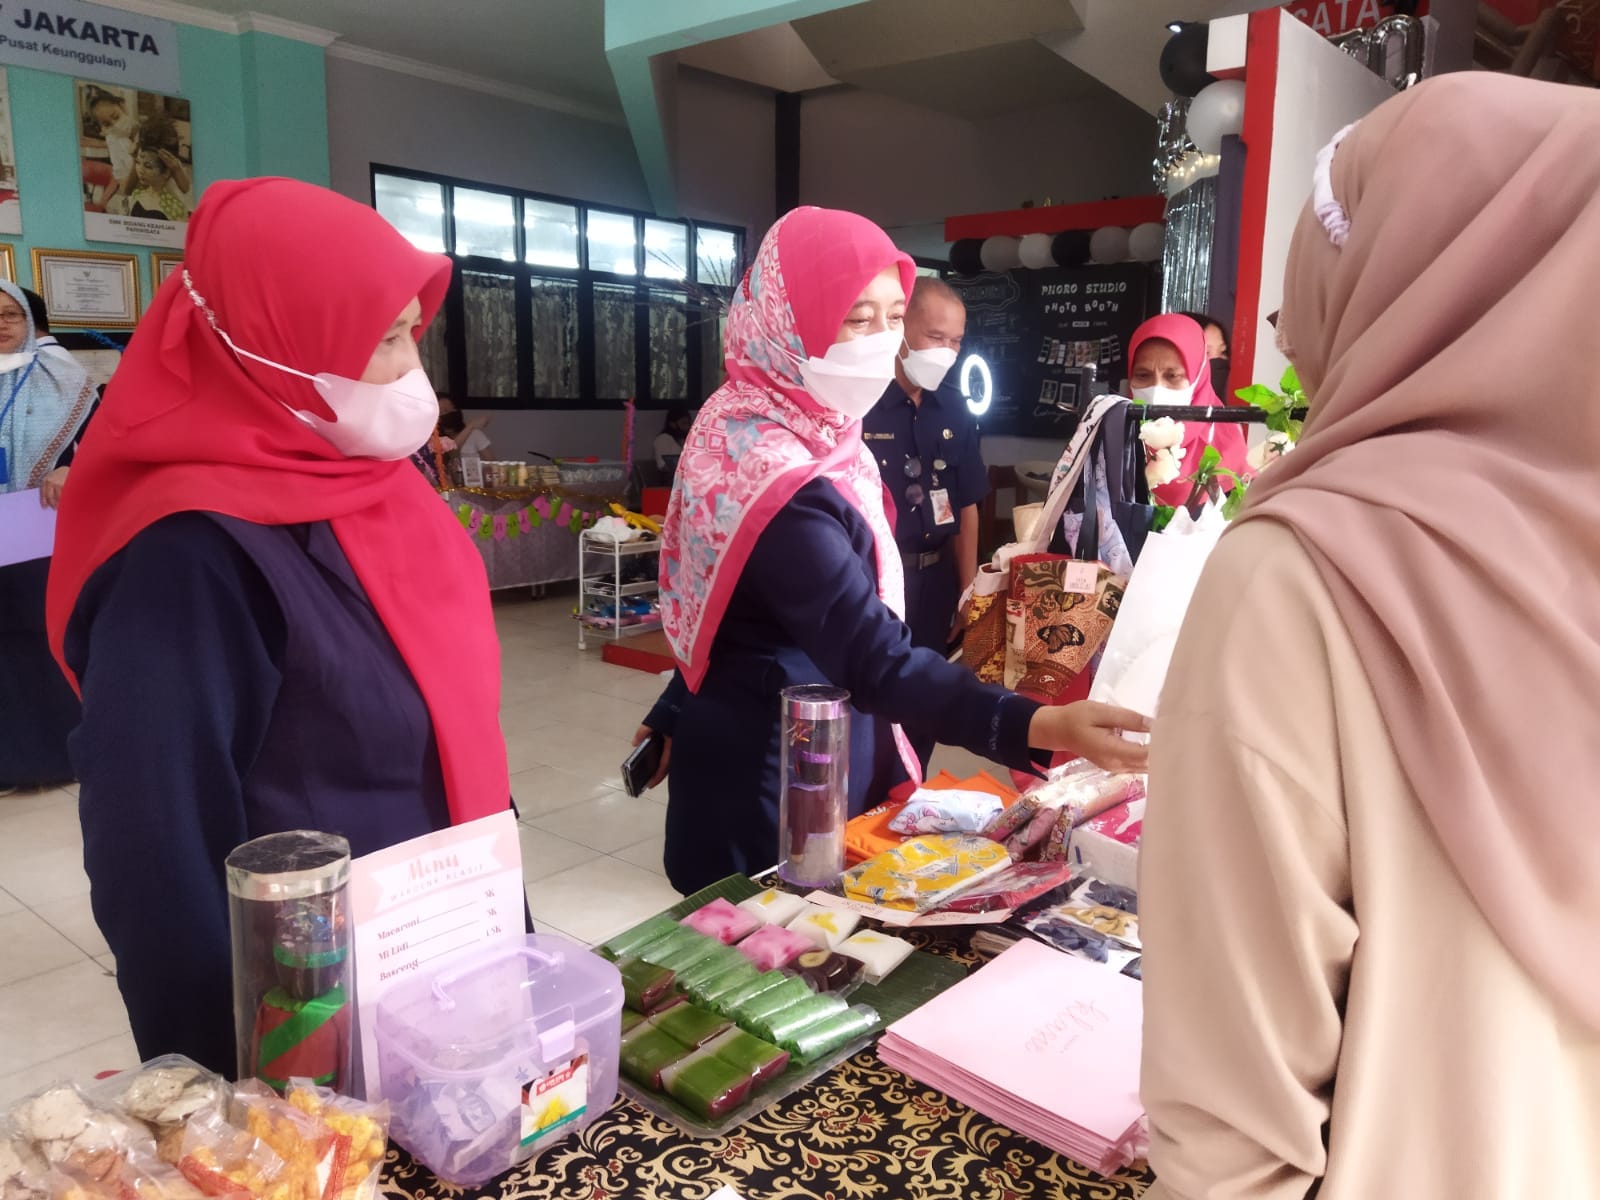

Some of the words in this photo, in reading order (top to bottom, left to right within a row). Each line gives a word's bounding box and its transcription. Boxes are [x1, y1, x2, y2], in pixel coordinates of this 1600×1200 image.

[15, 9, 159, 56] JAKARTA
[42, 43, 126, 70] Keunggulan)
[1085, 282, 1127, 294] STUDIO
[1045, 302, 1077, 313] PHOTO
[1085, 300, 1119, 312] BOOTH
[408, 854, 460, 880] Menu
[377, 916, 420, 940] Macaroni
[378, 951, 390, 960] Mi
[391, 942, 409, 956] Lidi
